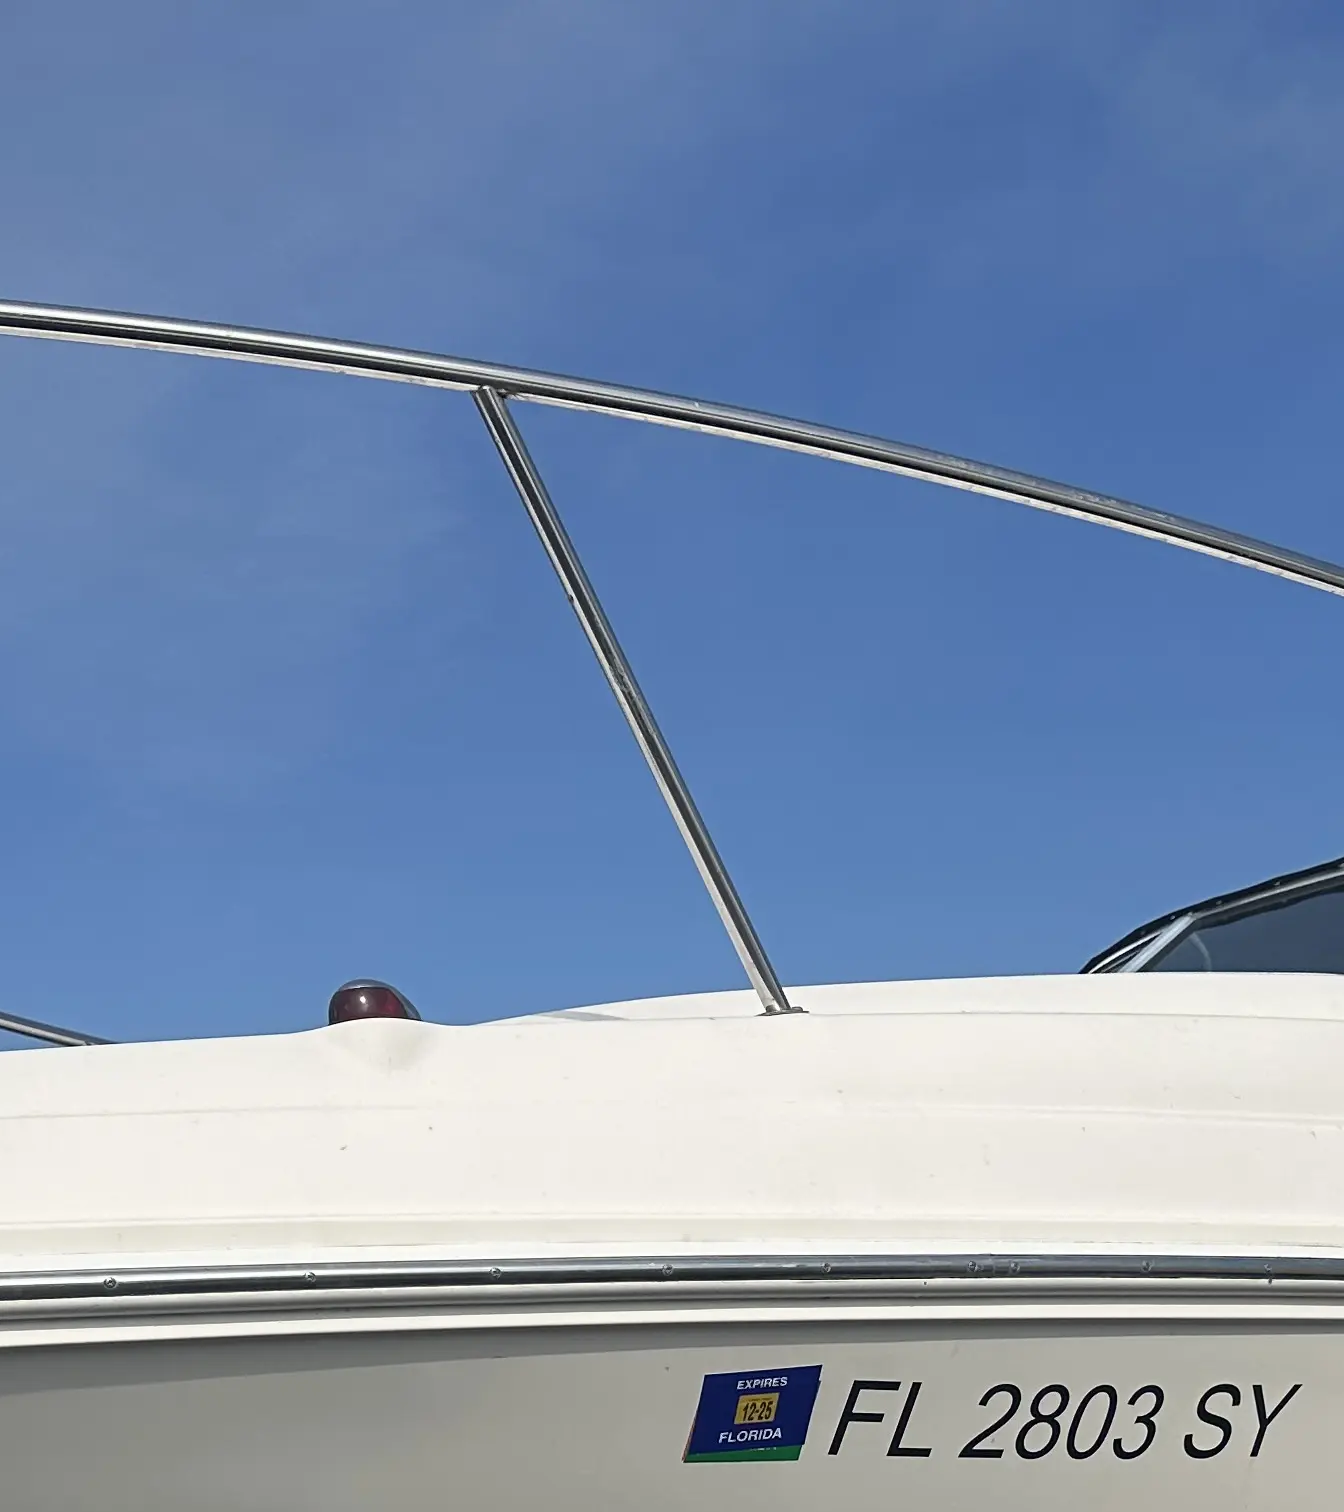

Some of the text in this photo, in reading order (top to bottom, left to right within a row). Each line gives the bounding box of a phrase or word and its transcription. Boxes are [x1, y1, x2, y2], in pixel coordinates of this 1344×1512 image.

[736, 1376, 788, 1390] EXPIRES
[742, 1400, 774, 1422] 12-25
[827, 1379, 1304, 1460] FL 2803 SY
[718, 1427, 782, 1443] FLORIDA
